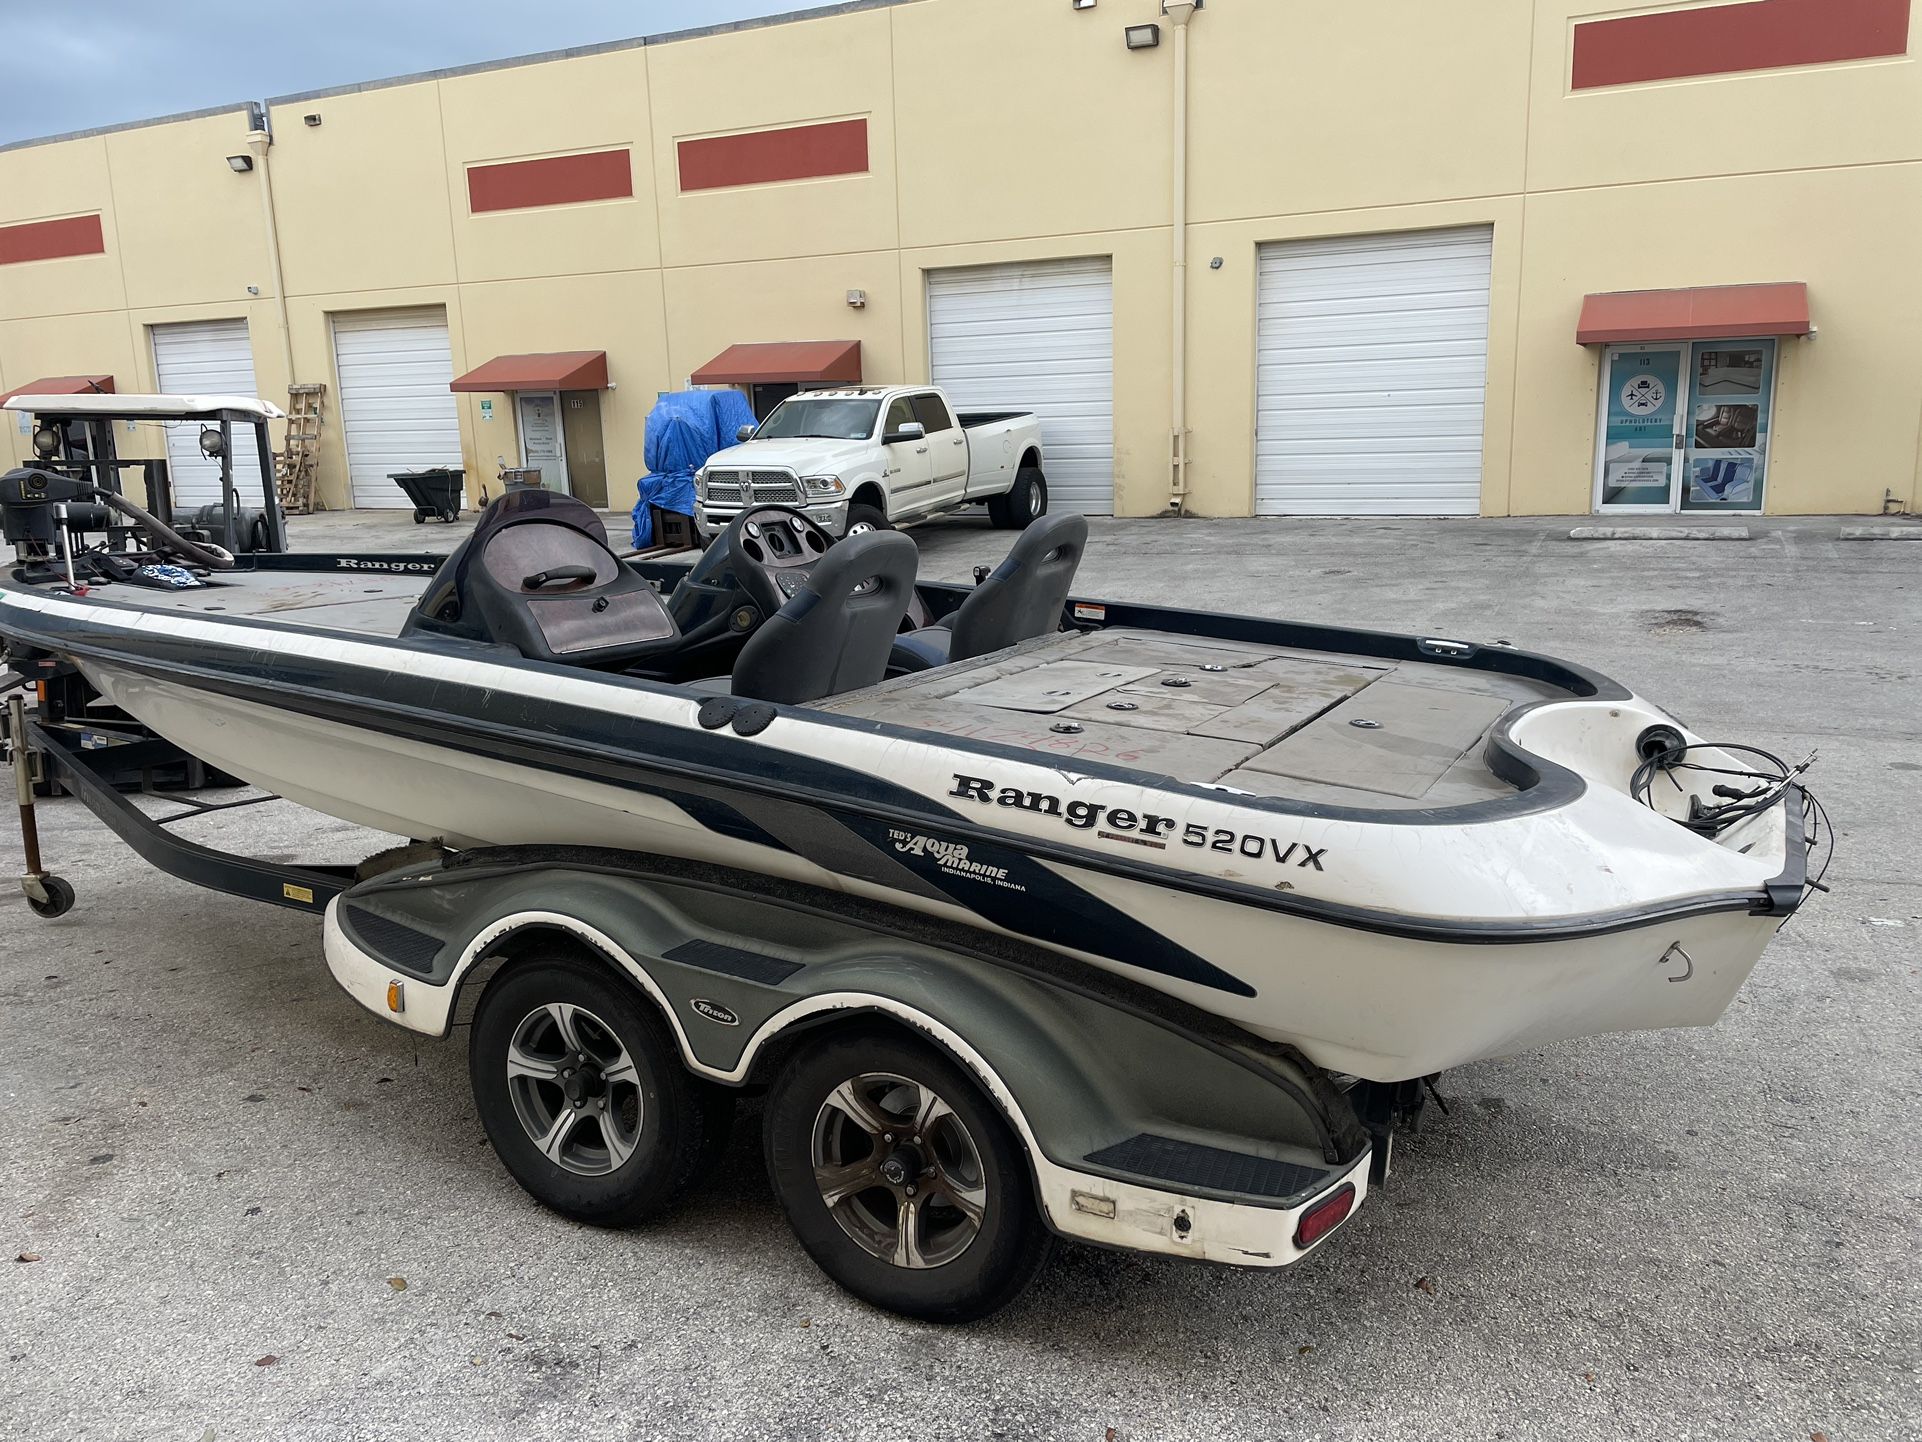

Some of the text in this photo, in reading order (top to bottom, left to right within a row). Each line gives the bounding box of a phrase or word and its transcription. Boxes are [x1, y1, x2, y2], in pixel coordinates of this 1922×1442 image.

[1640, 358, 1650, 366] 113
[337, 558, 435, 572] Ranger
[949, 772, 1328, 872] Ranger 520VX
[888, 828, 969, 860] TED'S Aqua
[941, 866, 1026, 892] INDIANAPOLIS, INDIANA
[698, 1001, 732, 1021] Triton
